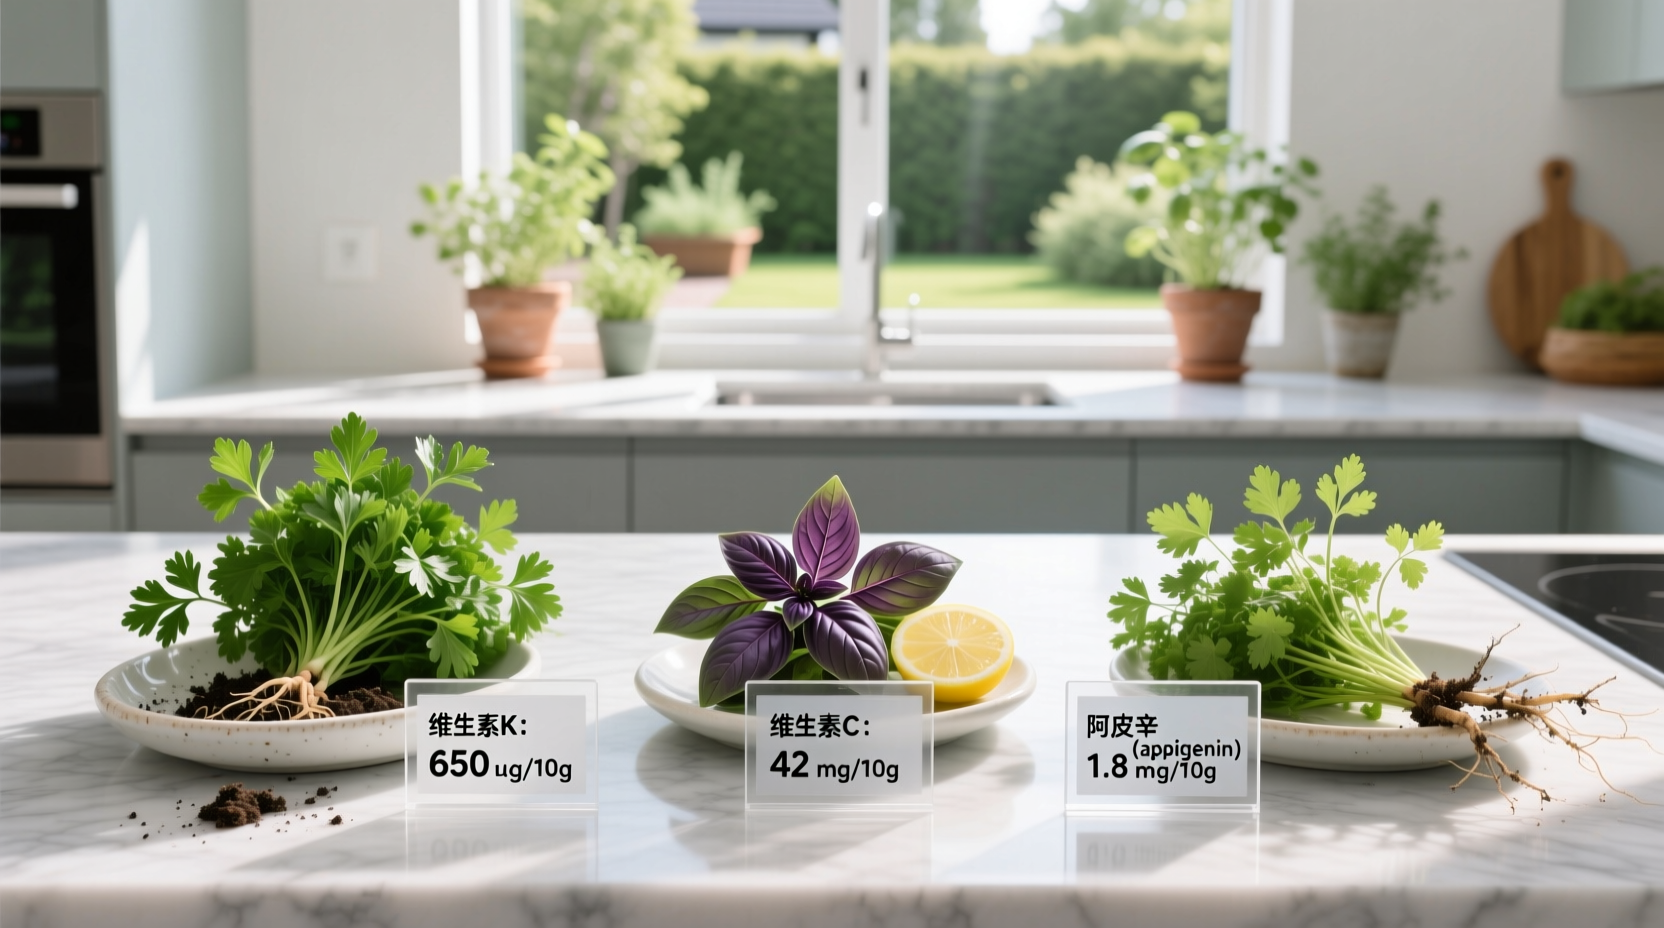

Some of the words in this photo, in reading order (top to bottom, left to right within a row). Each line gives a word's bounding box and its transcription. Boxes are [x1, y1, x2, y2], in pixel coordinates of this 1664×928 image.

[1087, 712, 1159, 739] 阿皮辛
[1132, 738, 1241, 761] (appigenin)
[429, 749, 490, 778] 650
[495, 757, 572, 784] ug/10g
[769, 749, 809, 778] 42
[817, 757, 899, 784] mg/10g
[1087, 752, 1128, 779] 1.8
[1135, 760, 1217, 785] mg/10g
